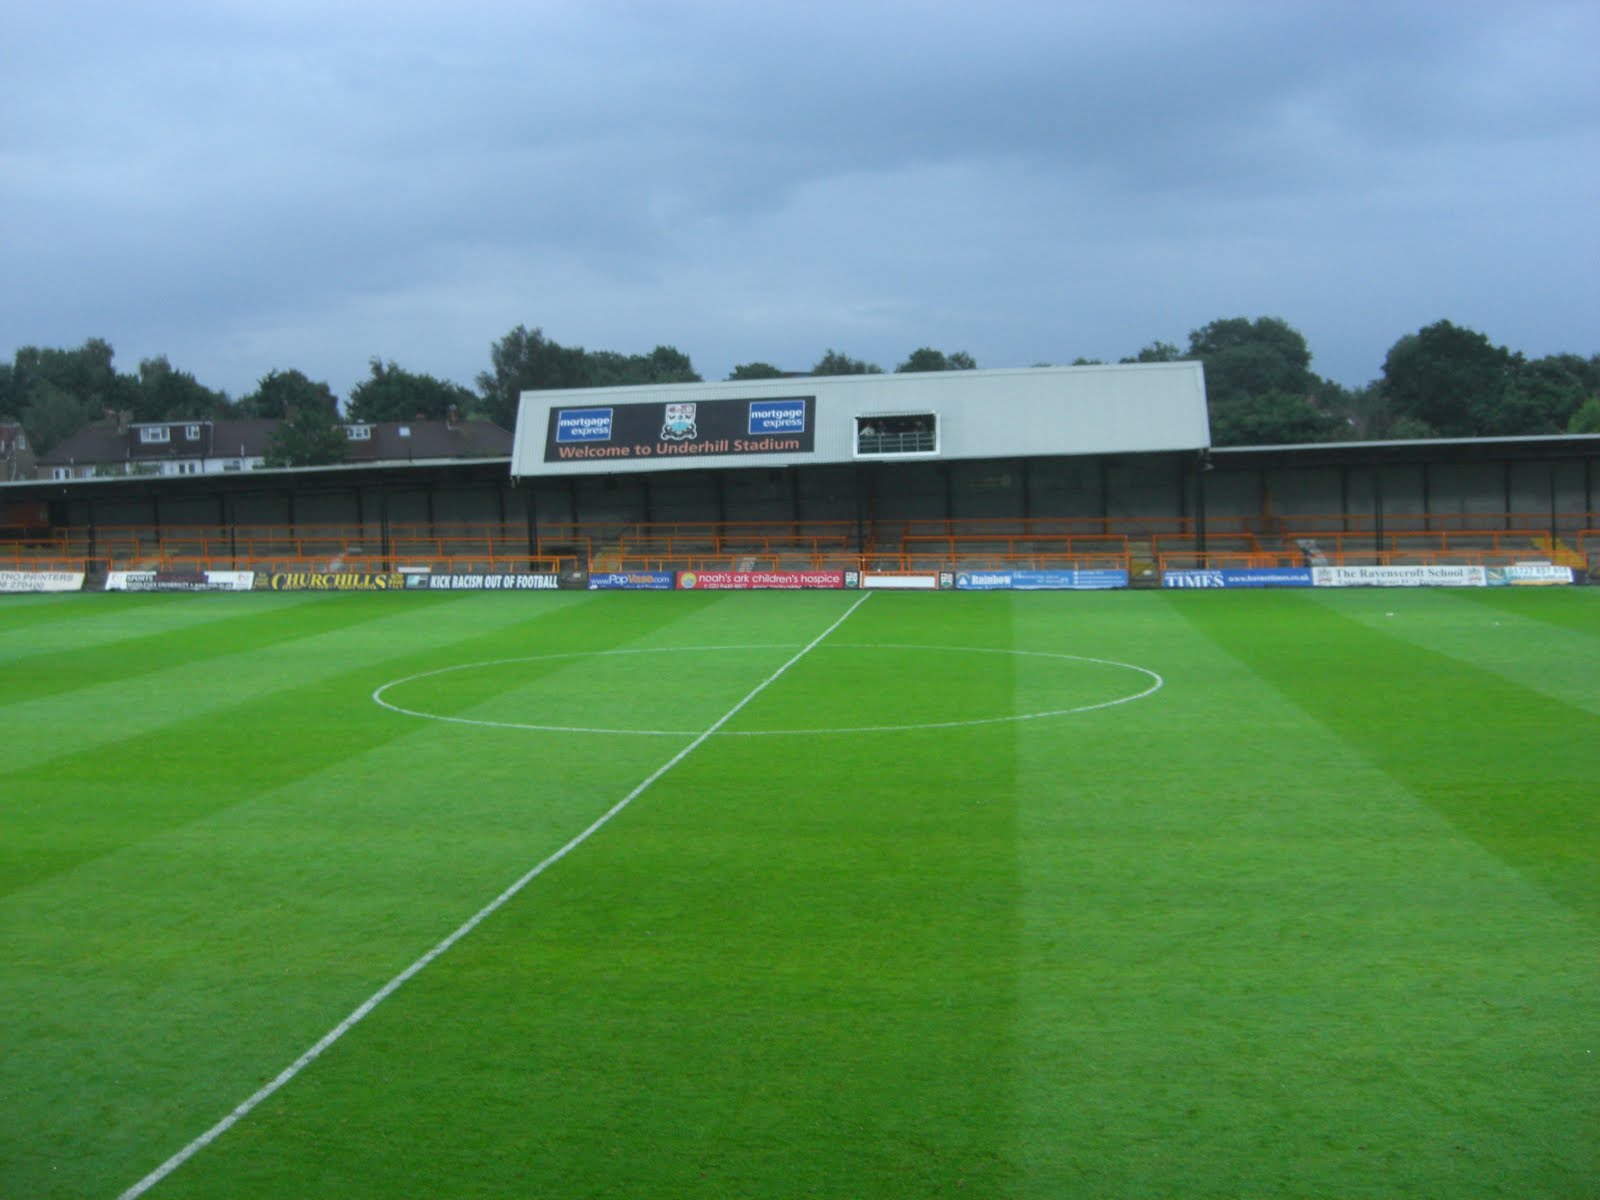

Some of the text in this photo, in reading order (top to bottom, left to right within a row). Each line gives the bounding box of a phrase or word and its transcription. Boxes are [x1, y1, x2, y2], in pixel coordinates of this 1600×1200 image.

[752, 409, 802, 419] mortgage
[560, 417, 610, 427] mortgage
[763, 417, 802, 428] express
[571, 426, 609, 437] express
[559, 438, 799, 458] Welcome to Underhill Stadium
[1336, 568, 1464, 577] The Ravenscroft School
[271, 572, 387, 590] CHURCHILLS
[430, 574, 558, 588] KICK RACISM OUT OF FOOTBALL
[699, 573, 840, 586] noah's ark children's hospice
[971, 575, 1012, 585] Rainbow
[1163, 575, 1225, 588] TIMES
